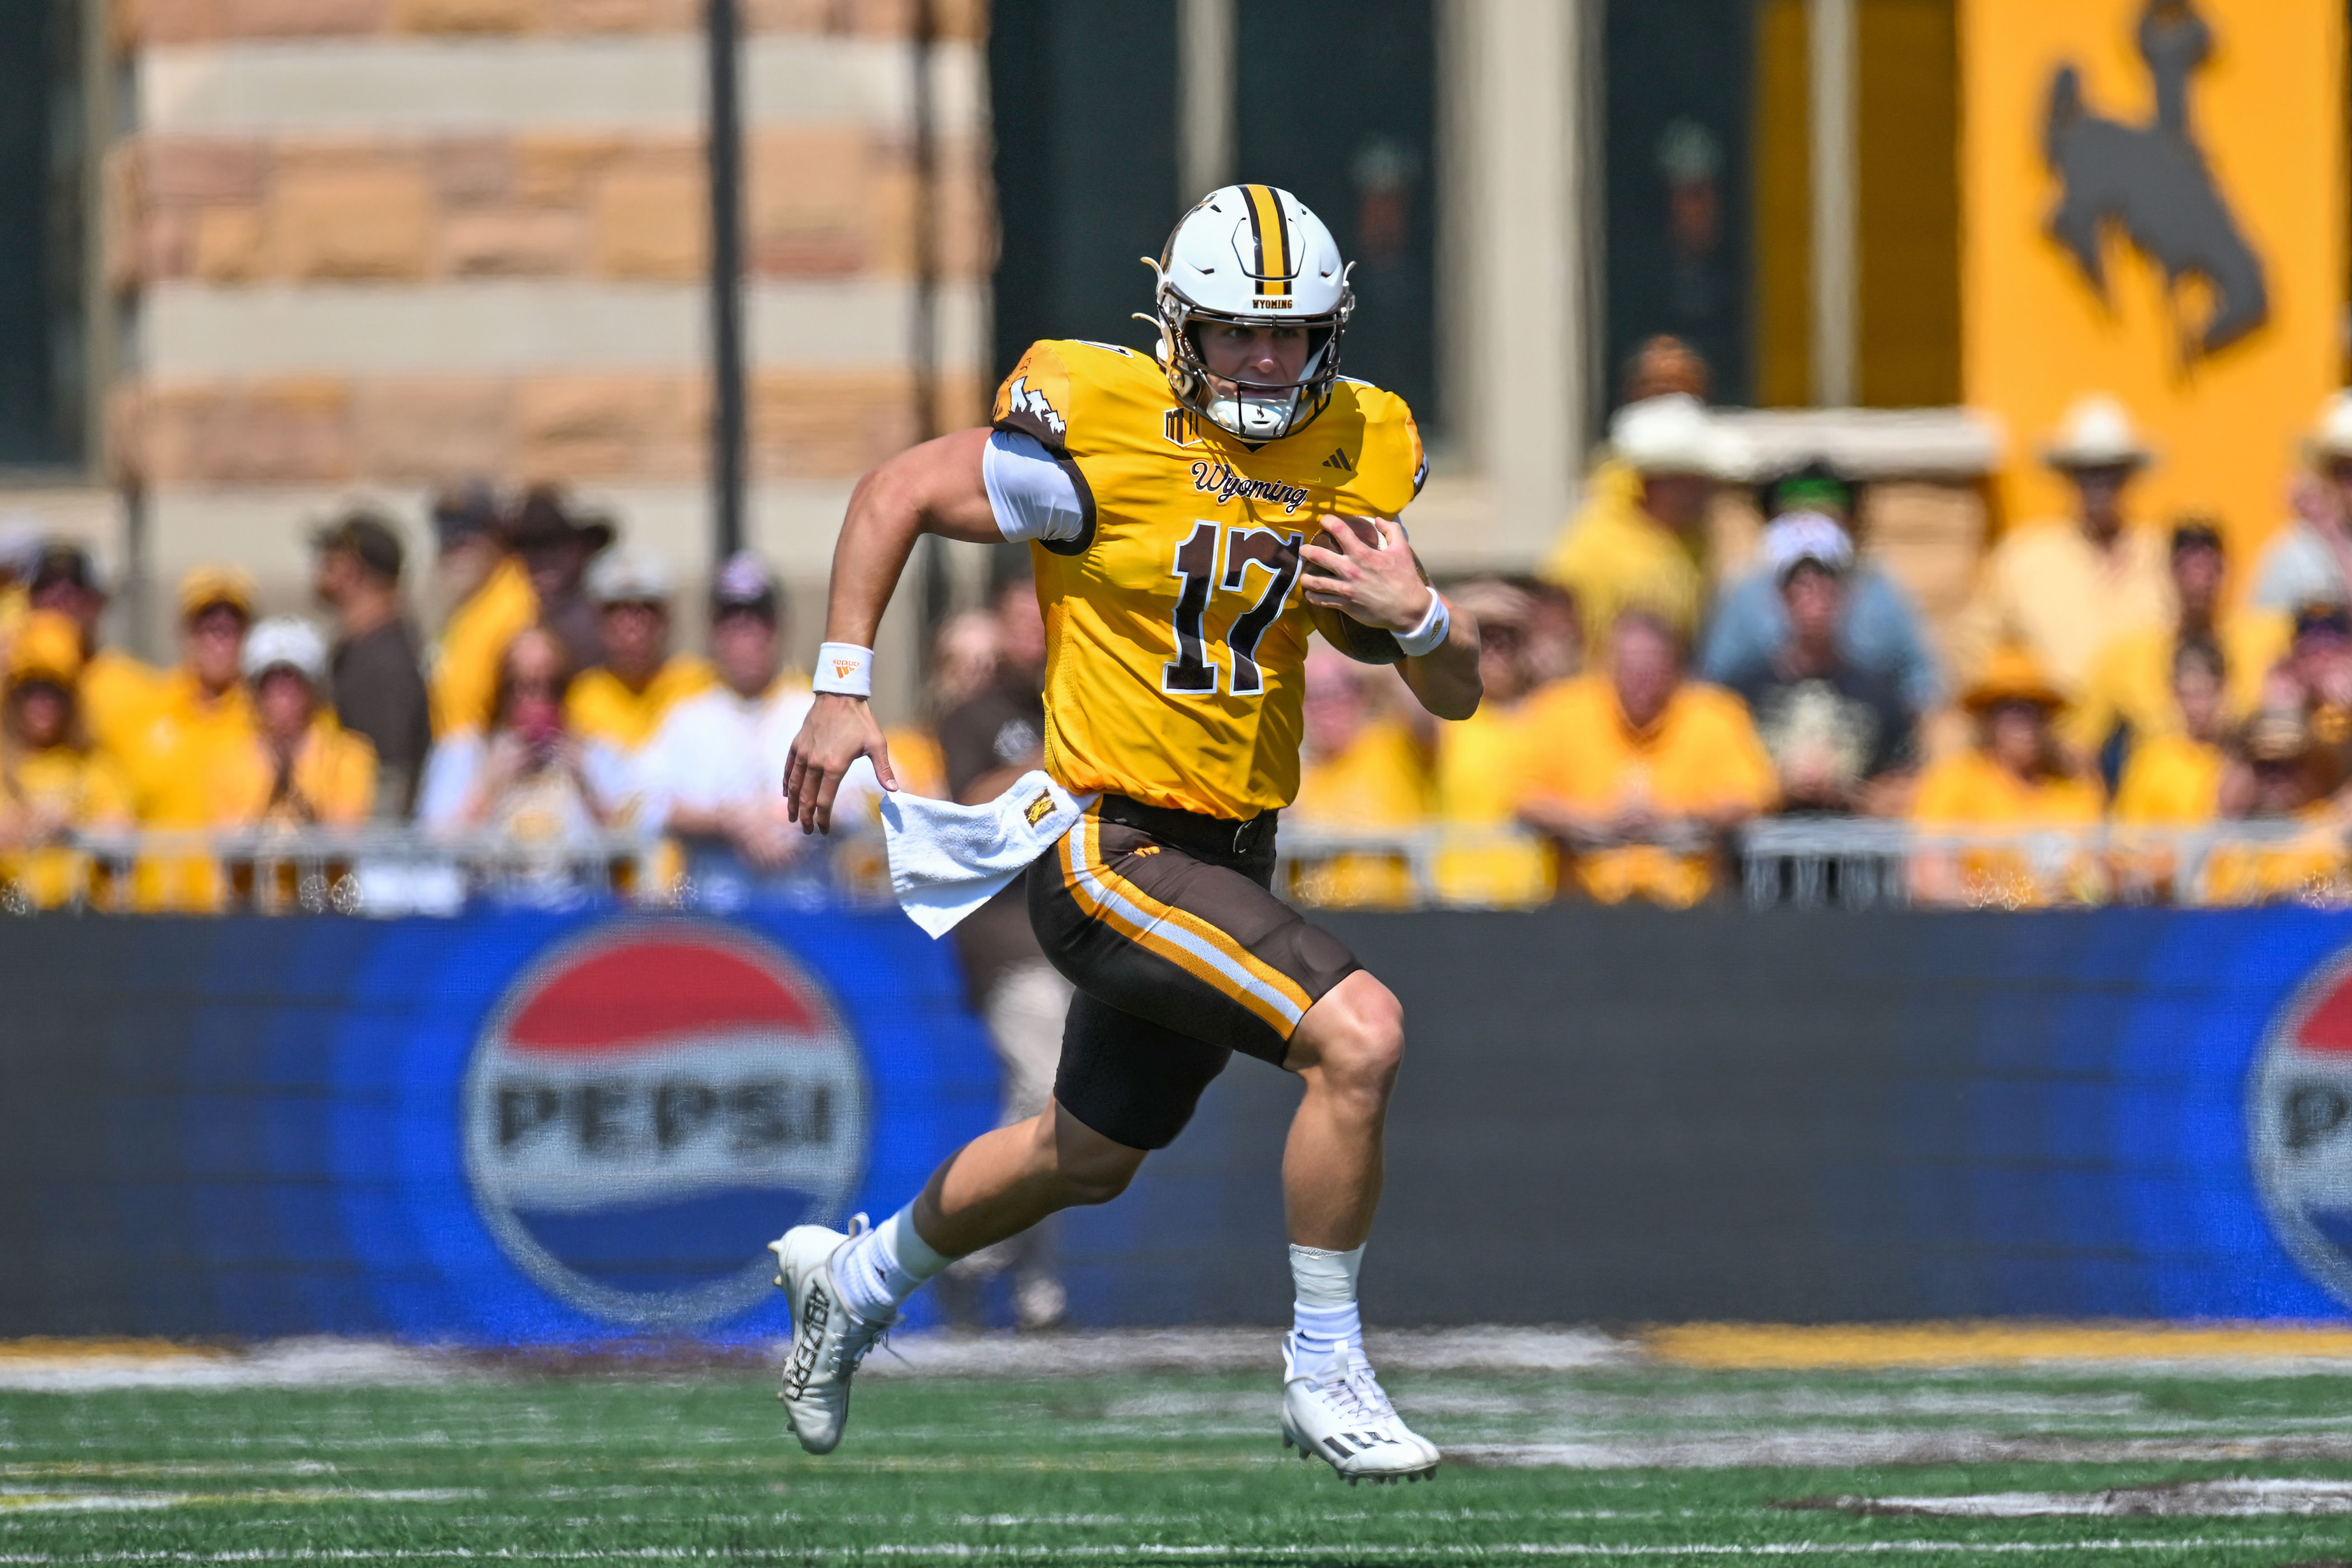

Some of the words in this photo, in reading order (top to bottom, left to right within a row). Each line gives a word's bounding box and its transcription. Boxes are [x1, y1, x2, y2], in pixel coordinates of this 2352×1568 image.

[1252, 299, 1292, 309] WYOMING
[1192, 461, 1310, 515] Wyoming
[1162, 519, 1304, 696] 17
[495, 1078, 833, 1152] PEPSI
